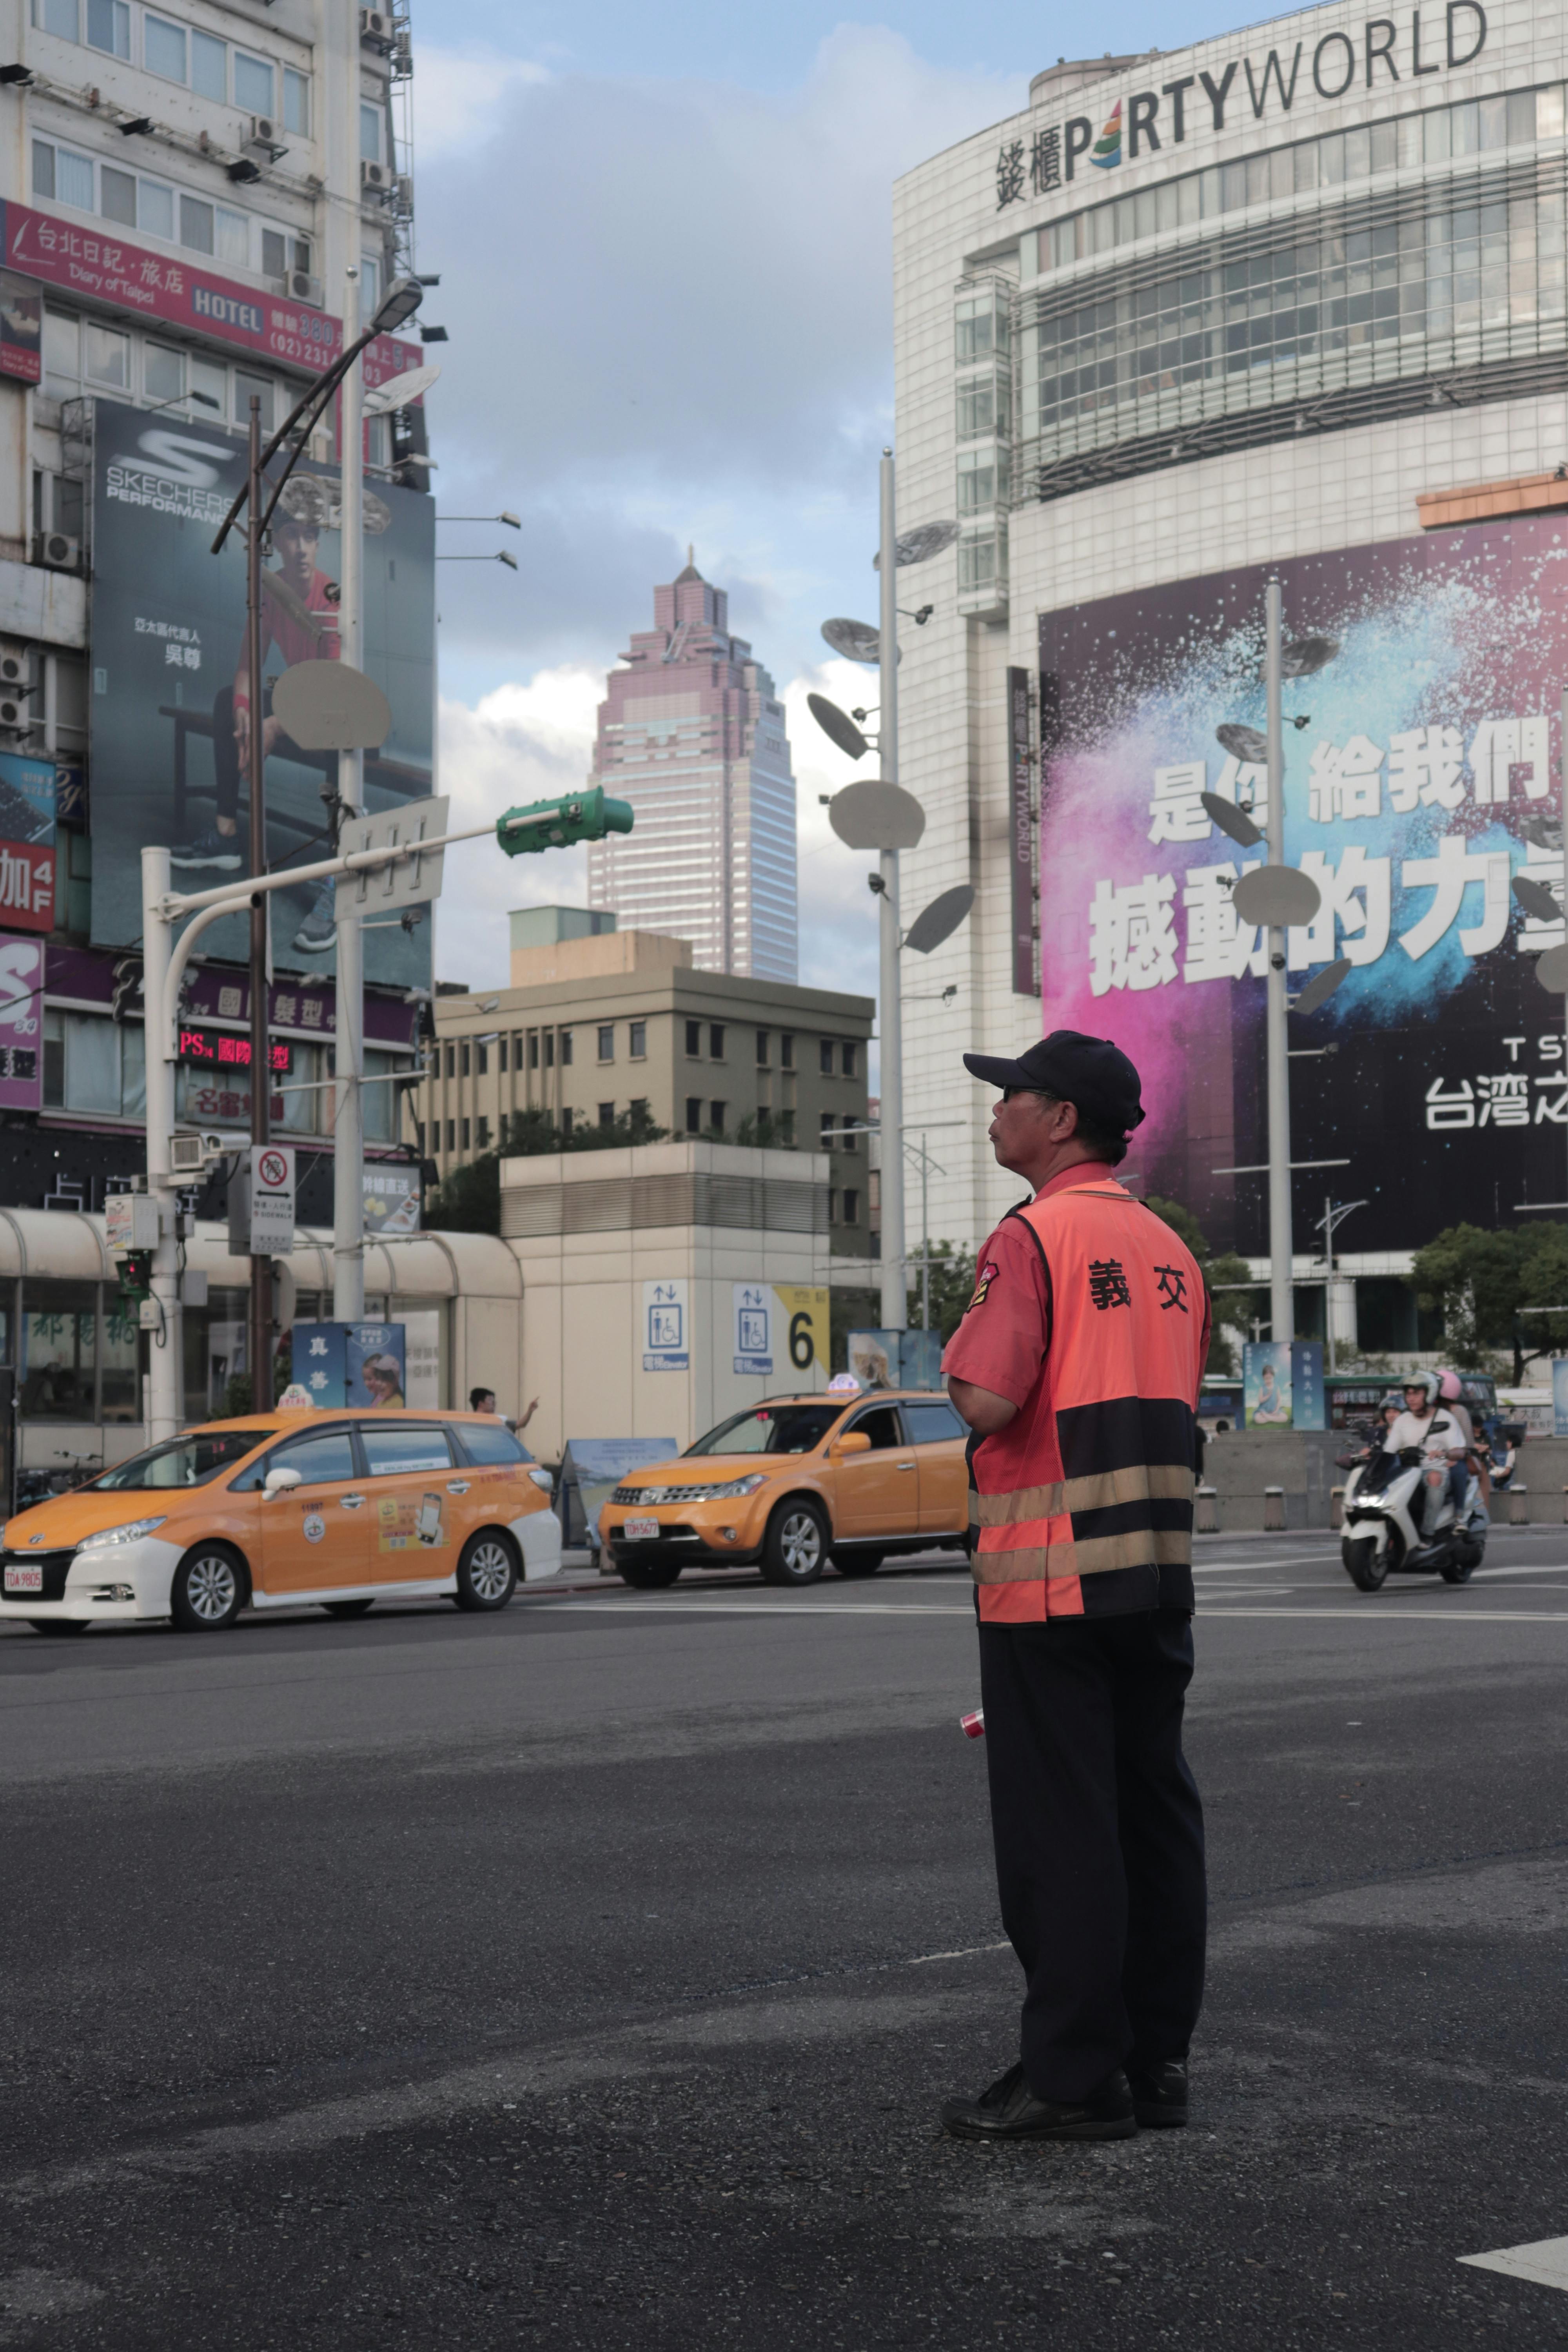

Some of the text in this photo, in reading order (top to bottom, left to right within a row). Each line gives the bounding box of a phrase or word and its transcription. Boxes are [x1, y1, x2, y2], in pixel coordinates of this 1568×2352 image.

[996, 125, 1062, 212] 錢櫃
[69, 262, 154, 303] Diary of Taipei
[196, 288, 261, 332] HOTEL
[107, 466, 236, 512] SKECHERS
[107, 486, 240, 529] PERFORMANC
[134, 617, 201, 645] 亞太區代言人
[165, 644, 201, 670] 吳尊
[218, 986, 323, 1027] 國髮型
[218, 1037, 289, 1069] 國際型
[1502, 1037, 1526, 1062] T
[789, 1311, 814, 1370] 6
